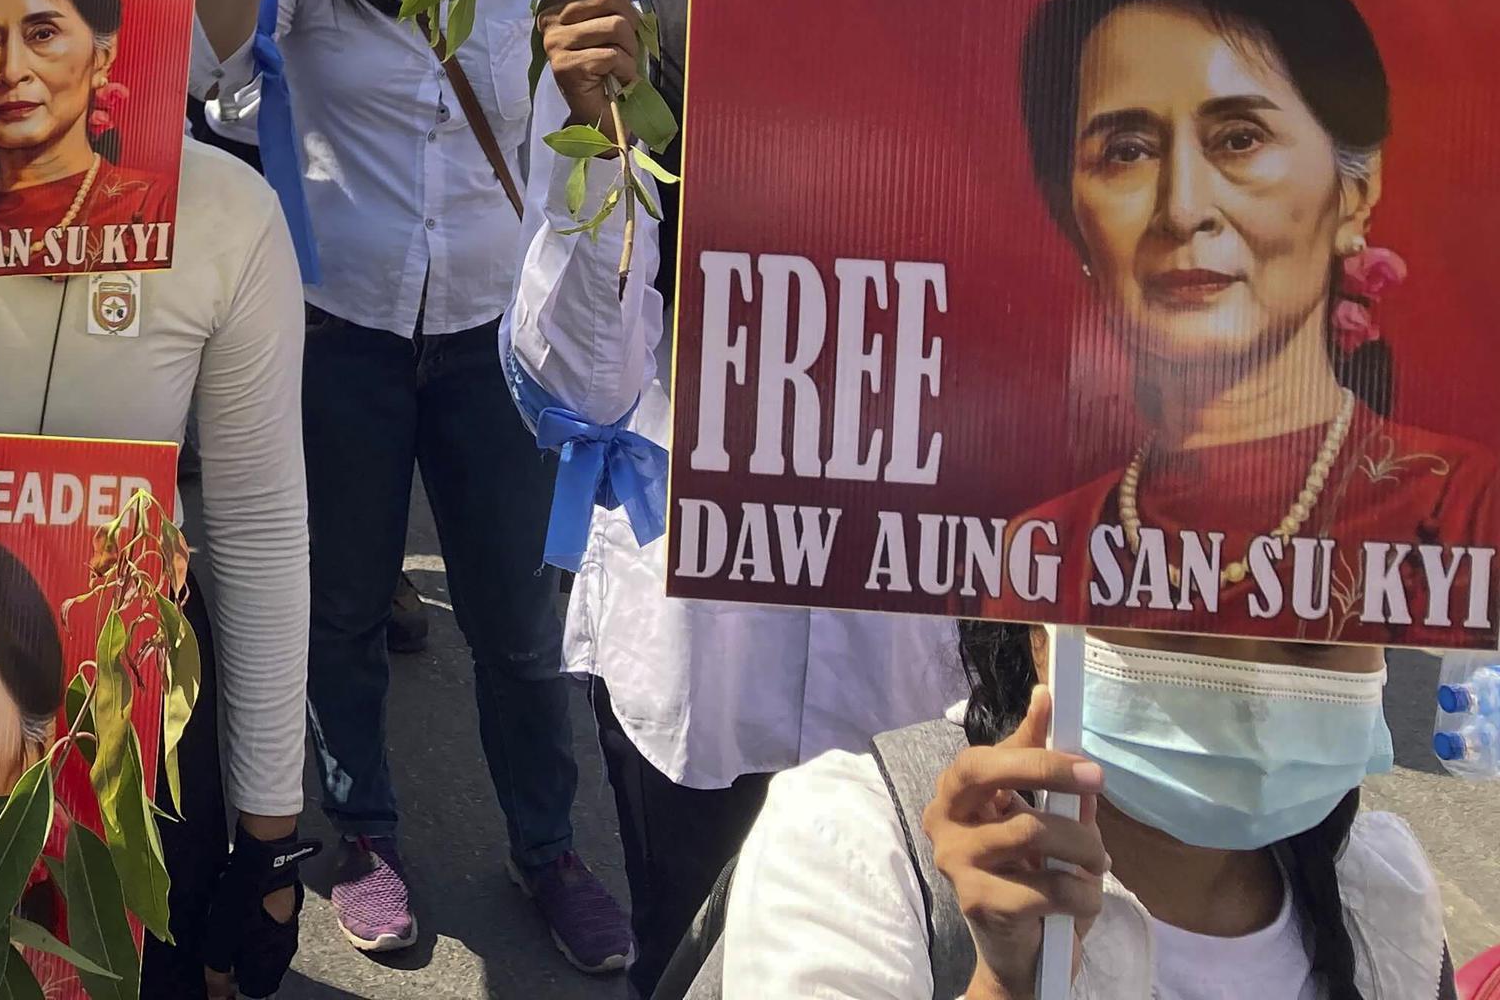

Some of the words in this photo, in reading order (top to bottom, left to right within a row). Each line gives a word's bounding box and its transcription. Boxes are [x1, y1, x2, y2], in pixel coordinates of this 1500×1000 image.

[42, 224, 91, 267] SU
[100, 222, 172, 266] KYI
[690, 250, 949, 486] FREE
[674, 499, 842, 588] DAW
[864, 511, 1062, 602] AUNG
[1087, 526, 1224, 614] SAN
[1247, 536, 1338, 621] SU
[1357, 543, 1496, 629] KYI
